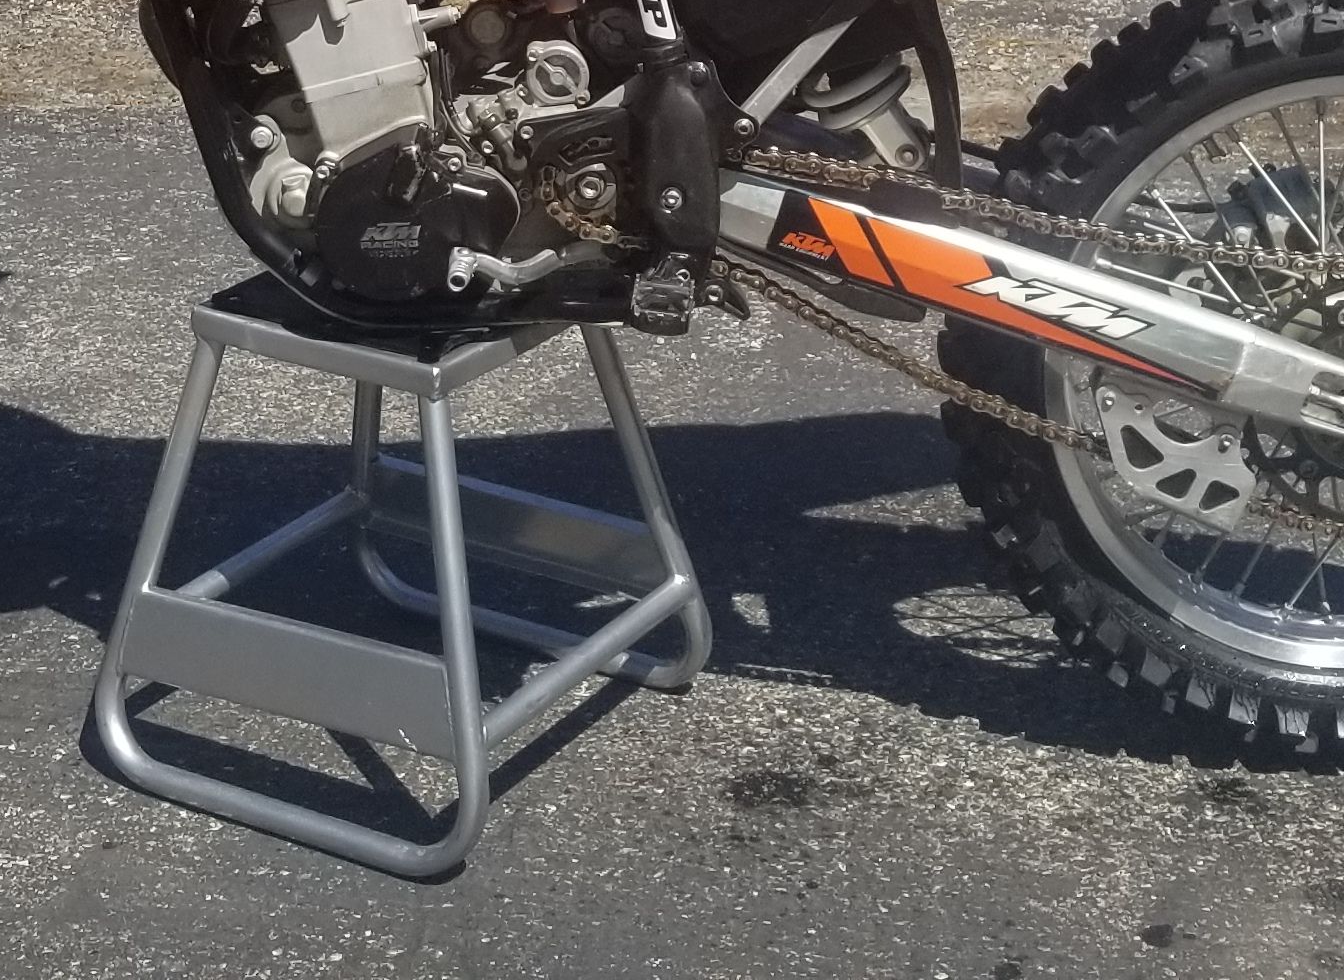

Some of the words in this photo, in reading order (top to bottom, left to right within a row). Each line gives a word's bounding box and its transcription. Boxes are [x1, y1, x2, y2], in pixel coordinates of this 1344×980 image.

[360, 222, 421, 240] KTM
[782, 232, 835, 258] KTM
[956, 276, 1155, 340] KTM
